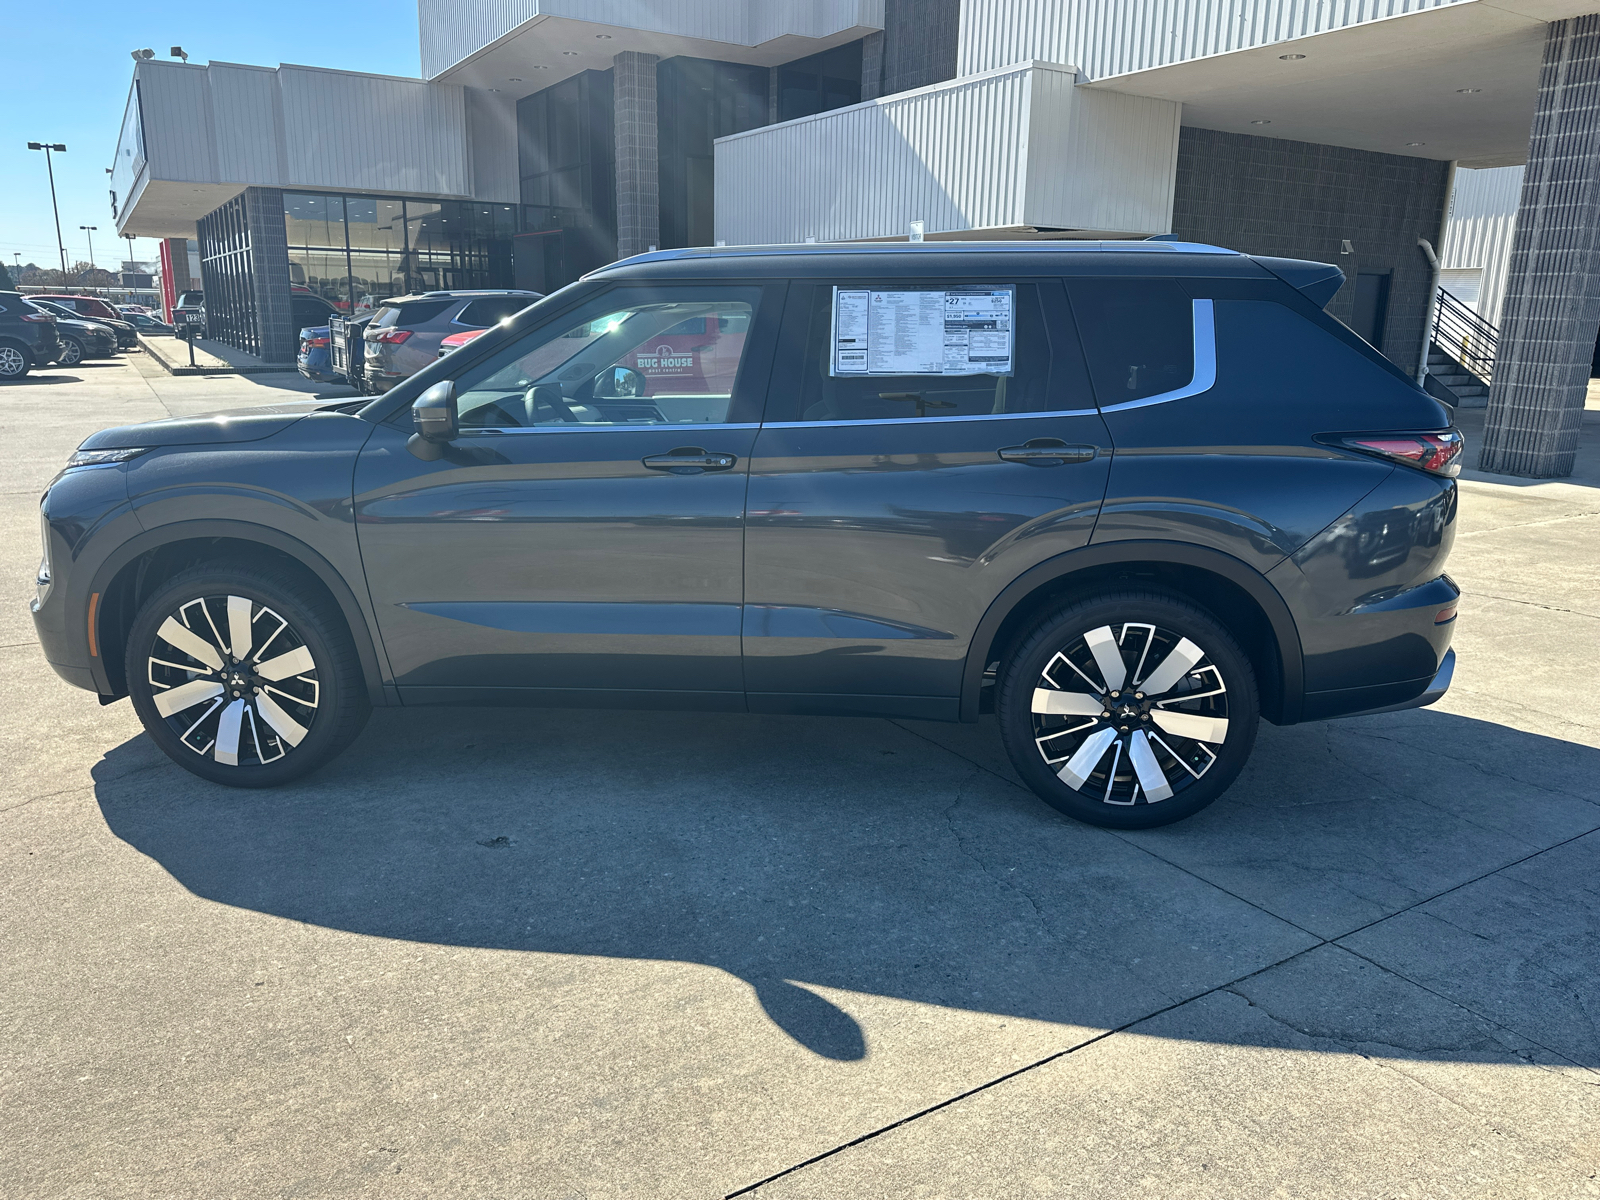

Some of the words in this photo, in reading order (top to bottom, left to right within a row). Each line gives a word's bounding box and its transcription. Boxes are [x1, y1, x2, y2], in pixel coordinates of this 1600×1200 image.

[949, 297, 960, 305] 27
[637, 358, 658, 368] BUG
[661, 358, 693, 367] HOUSE
